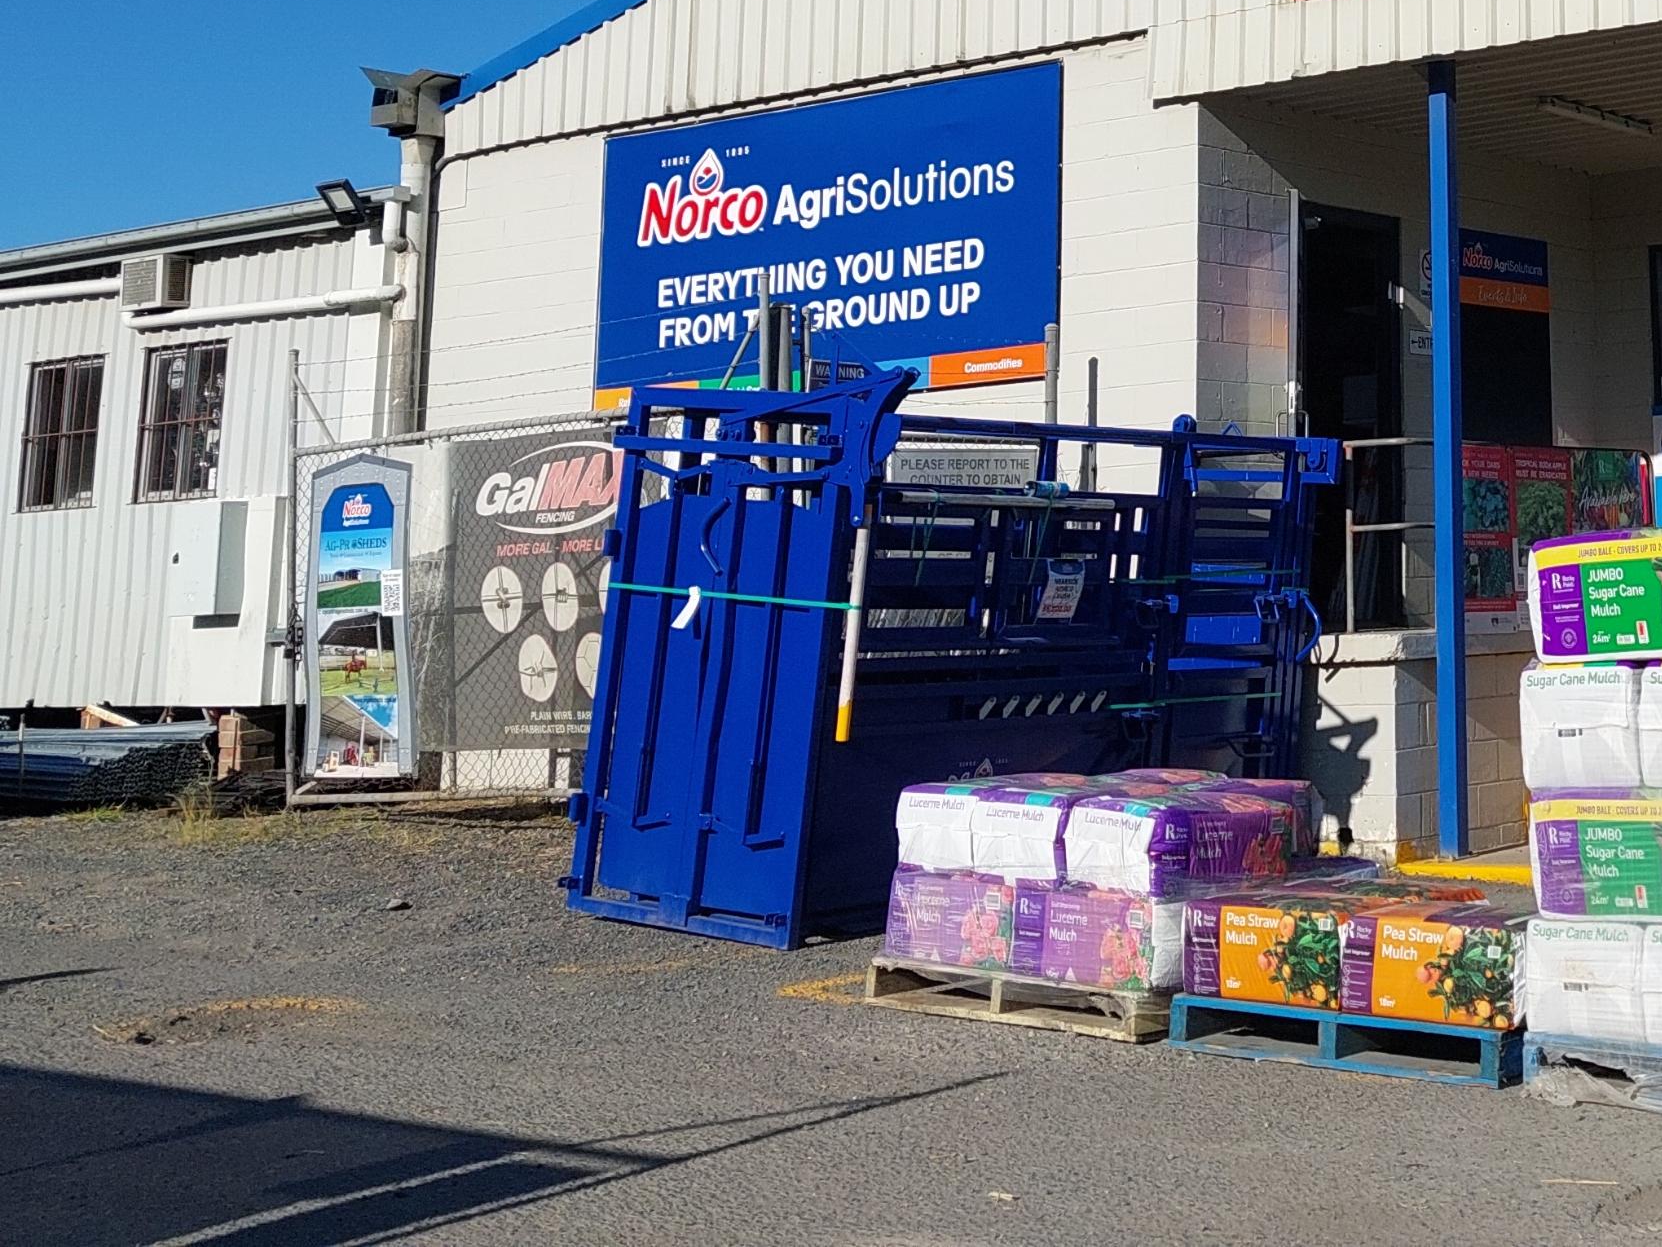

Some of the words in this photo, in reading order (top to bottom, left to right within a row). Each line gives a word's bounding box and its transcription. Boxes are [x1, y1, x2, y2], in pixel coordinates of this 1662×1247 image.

[661, 156, 691, 167] SINCE
[637, 175, 767, 247] Norco
[773, 160, 1014, 229] AgriSolutions
[1462, 247, 1494, 270] Norco
[1494, 260, 1543, 276] AgriSolutions
[658, 259, 826, 308] EVERYTHING
[835, 249, 893, 285] YOU
[903, 238, 984, 277] NEED
[659, 309, 735, 348] FROM
[807, 288, 930, 331] GROUND
[939, 282, 981, 316] UP
[815, 363, 865, 380] WANING
[901, 459, 944, 470] PLEASE
[948, 459, 991, 470] REPORT
[995, 459, 1008, 469] TO
[1011, 459, 1029, 469] THE
[910, 474, 963, 485] COUNTER
[967, 475, 980, 484] TO
[983, 474, 1021, 485] OBTAIN
[536, 511, 575, 523] FENCING
[496, 543, 531, 557] MORE
[531, 542, 552, 554] GAL
[562, 539, 593, 553] MORE
[1578, 548, 1598, 558] JUMBO
[1600, 546, 1612, 556] BALE
[1617, 545, 1639, 555] COVERS
[1650, 544, 1657, 552] TO
[1588, 568, 1624, 582] JUMBO
[1589, 587, 1617, 601] Sugar
[1619, 584, 1645, 597] Cane
[1591, 604, 1621, 617] Mulch
[1526, 674, 1558, 688] Sugar
[1559, 673, 1585, 686] Cane
[1587, 671, 1621, 685] Mulch
[531, 711, 551, 720] PLAIN
[908, 798, 940, 810] Lucerne
[941, 798, 965, 811] Mulch
[986, 806, 1020, 819] Lucerne
[1022, 808, 1044, 822] Mulch
[1585, 828, 1622, 841] JUMBO
[1586, 846, 1616, 861] Sugar
[1618, 846, 1645, 859] Cane
[1589, 863, 1620, 877] Mulch
[1050, 910, 1088, 925] Lucerne
[1225, 913, 1245, 927] Pea
[1247, 914, 1279, 929] Straw
[1049, 928, 1077, 942] Mulch
[1225, 930, 1258, 946] Mulch
[1382, 925, 1406, 941] Pea
[1407, 927, 1443, 945] Straw
[1532, 926, 1564, 941] Sugar
[1566, 926, 1593, 940] Cane
[1595, 927, 1629, 942] Mulch
[1381, 944, 1418, 962] Mulch
